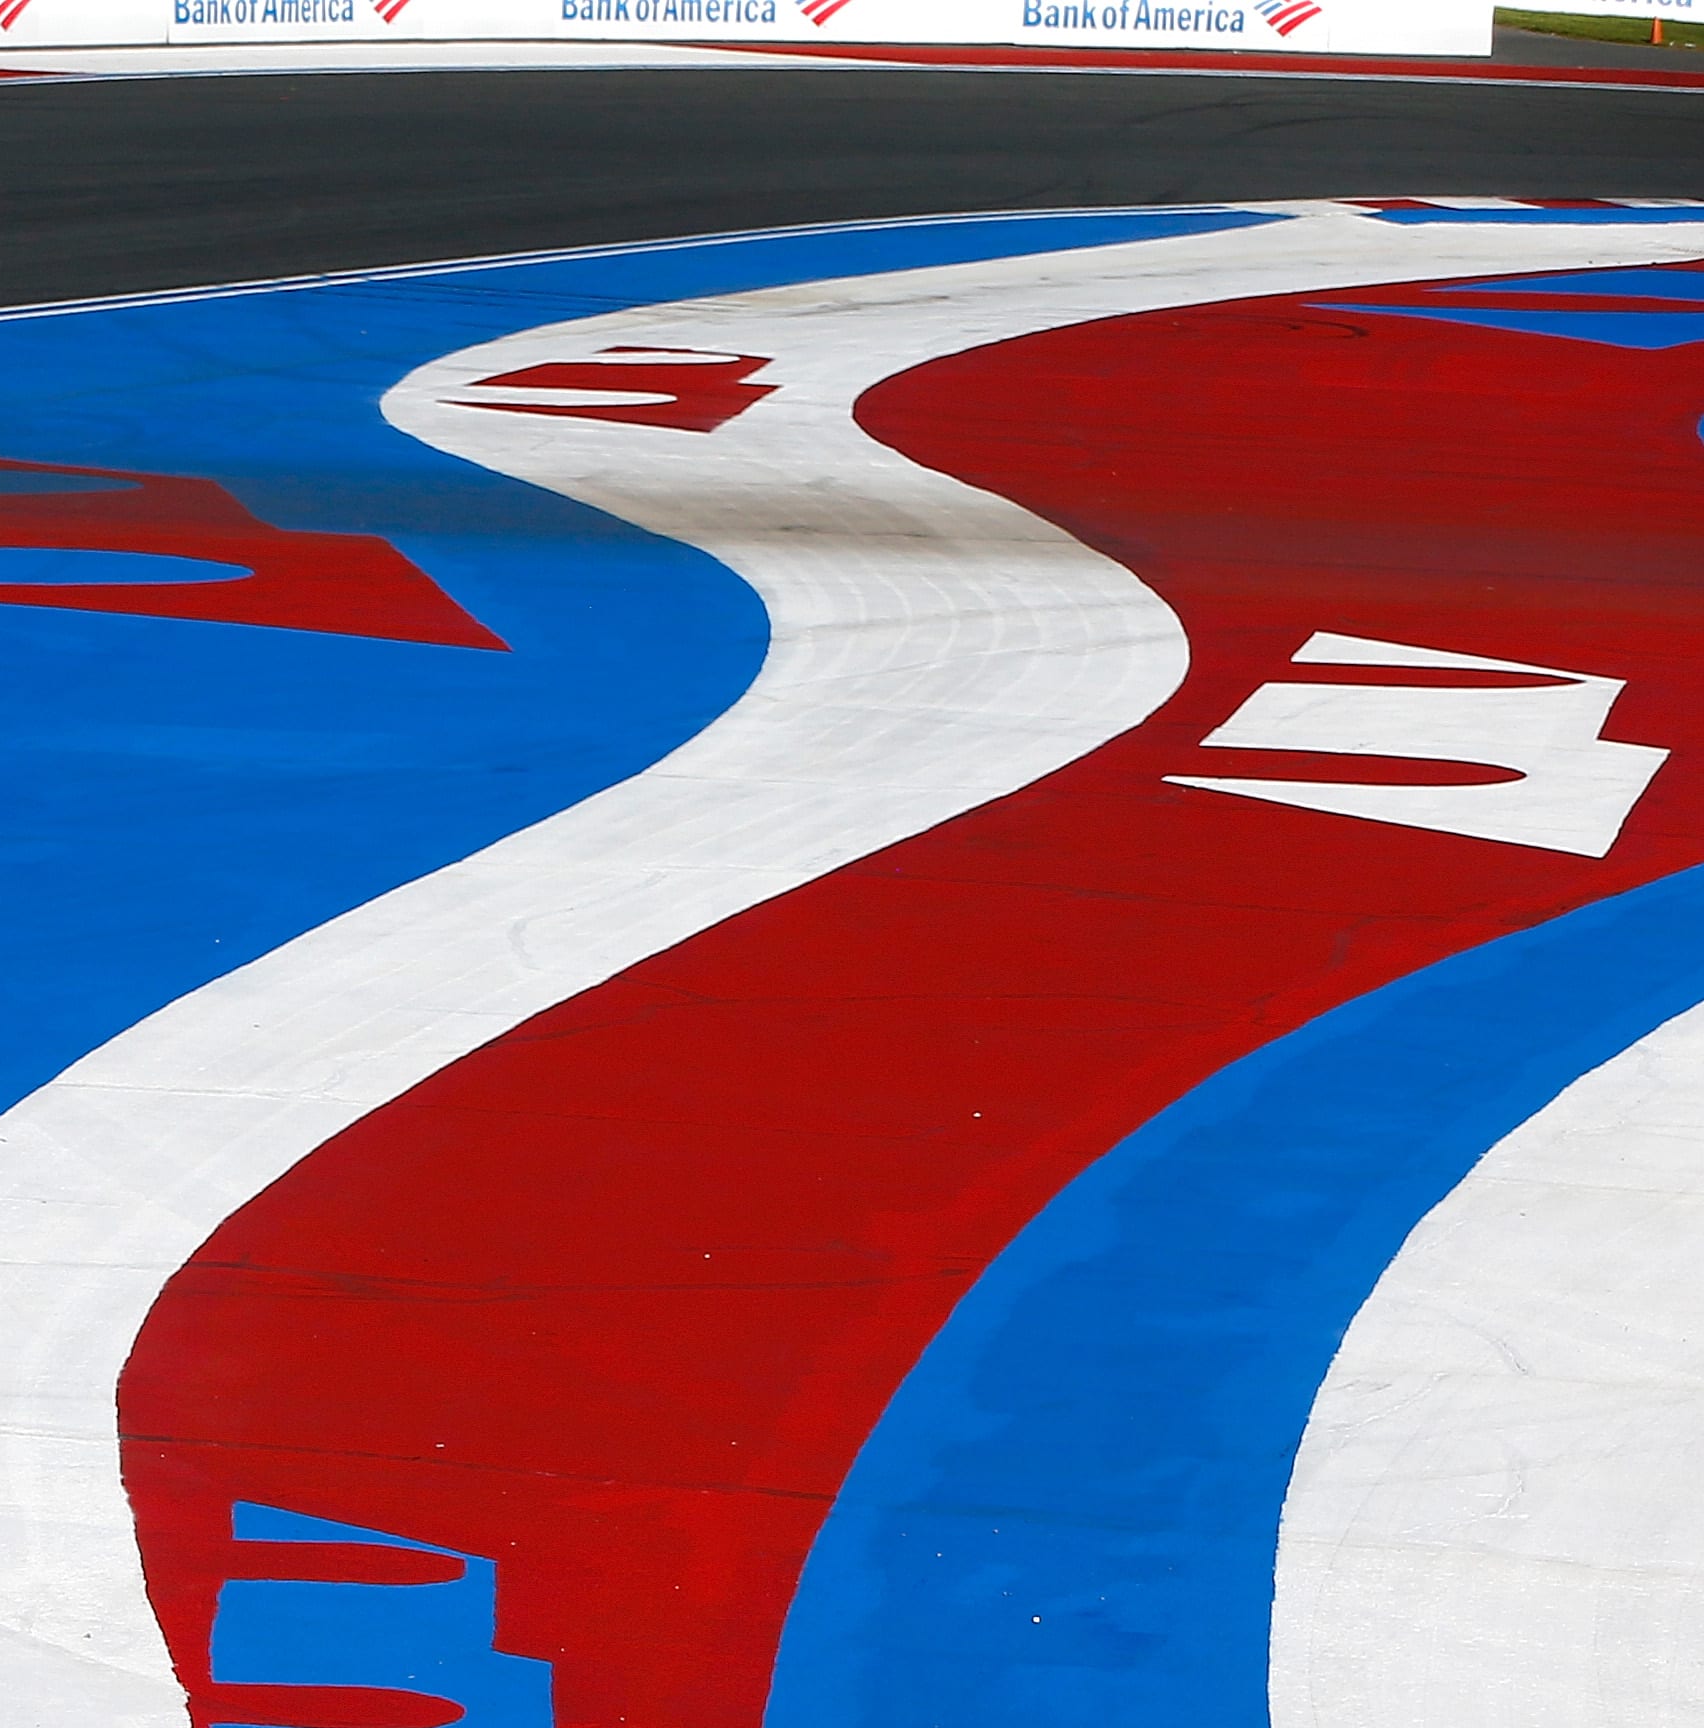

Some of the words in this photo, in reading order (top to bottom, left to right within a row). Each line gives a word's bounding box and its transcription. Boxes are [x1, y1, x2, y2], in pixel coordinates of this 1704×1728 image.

[174, 0, 231, 24] Bank
[1023, 0, 1096, 28] Bank
[1102, 0, 1129, 30] of
[1134, 0, 1244, 33] America
